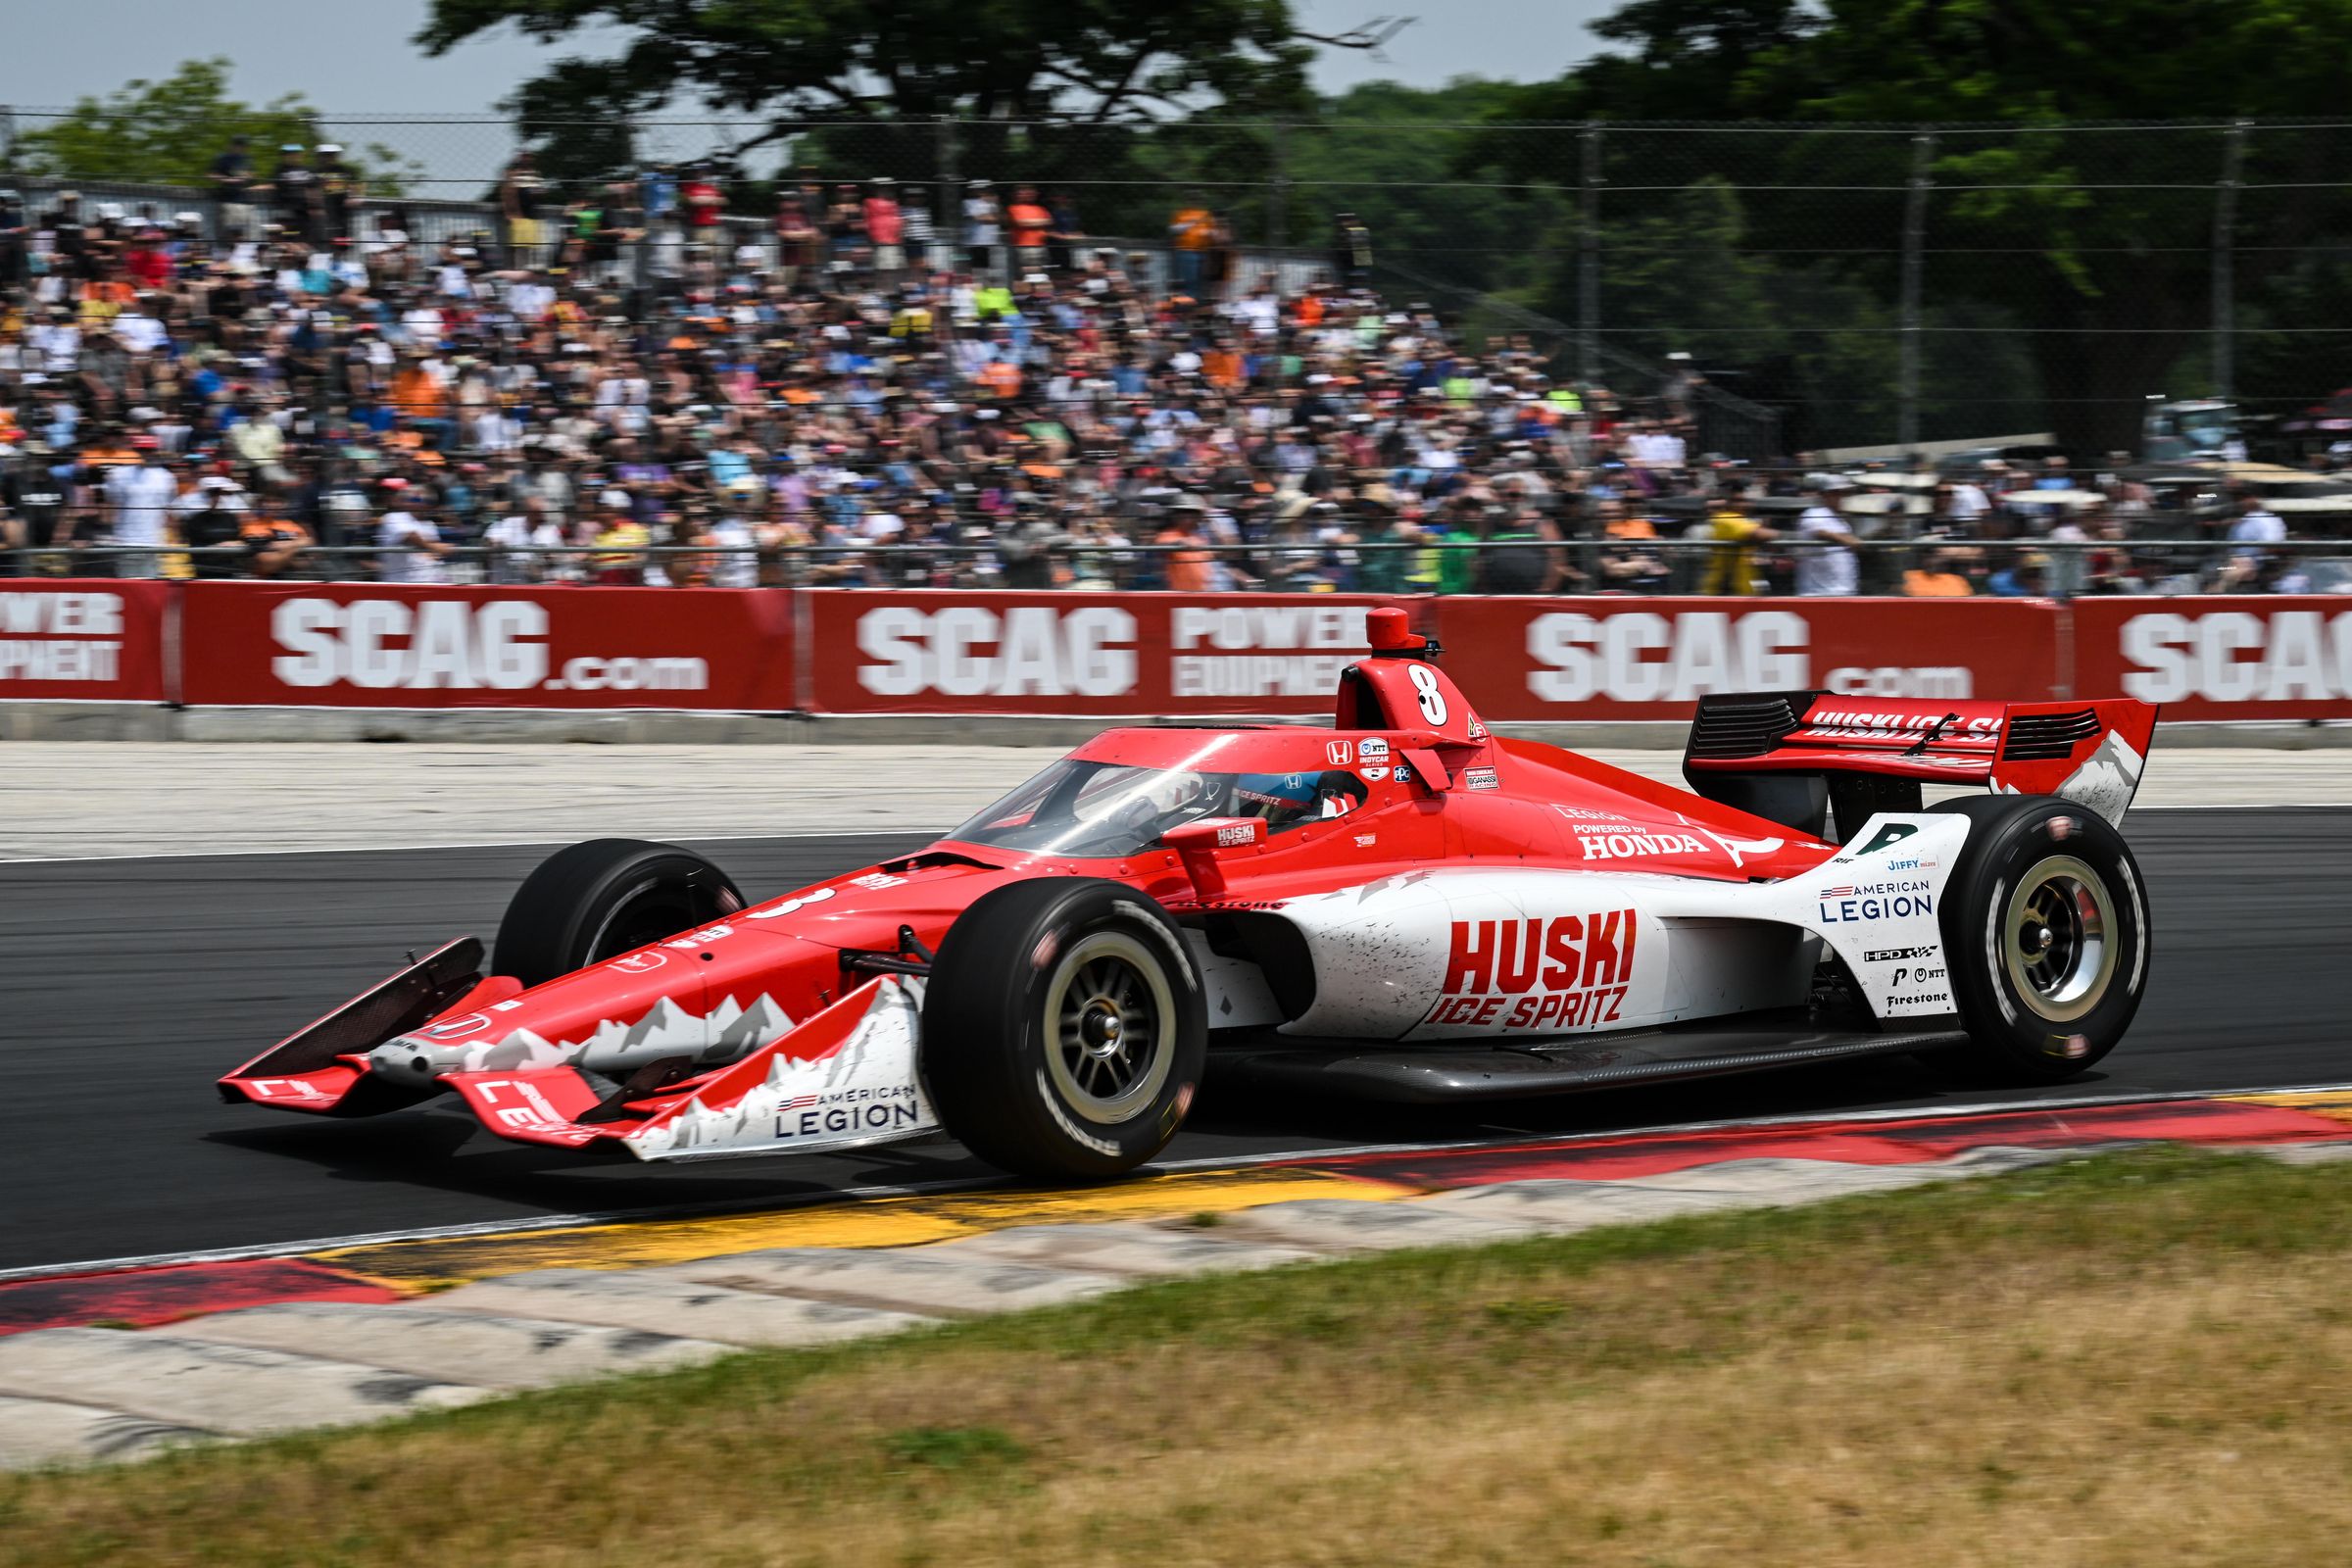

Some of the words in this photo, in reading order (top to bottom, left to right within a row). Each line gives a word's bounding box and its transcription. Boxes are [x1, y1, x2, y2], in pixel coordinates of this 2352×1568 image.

[1170, 606, 1374, 649] POWER
[271, 598, 709, 691] SCAG.com
[857, 606, 1138, 696] SCAG
[1525, 612, 1974, 702] SCAGcom
[1407, 663, 1447, 726] 8
[1803, 711, 1904, 739] HUSKI
[1395, 767, 1410, 780] PPG
[1250, 792, 1282, 806] SPRITZ
[1217, 824, 1254, 841] HUSKI
[1573, 824, 1631, 833] POWERED
[1632, 825, 1646, 834] by
[1578, 834, 1710, 860] HONDA
[1887, 859, 1919, 870] JIFFY
[1853, 880, 1930, 896] AMERICAN
[1820, 895, 1933, 923] LEGION
[1442, 907, 1637, 995] HUSKI
[1865, 950, 1902, 961] HPD
[1929, 969, 1945, 978] NTT
[1426, 997, 1506, 1025] ICE
[1505, 986, 1629, 1028] SPRITZ
[1886, 993, 1948, 1007] Firestone
[817, 1084, 916, 1105] AMERICAN
[776, 1101, 917, 1138] LEGION
